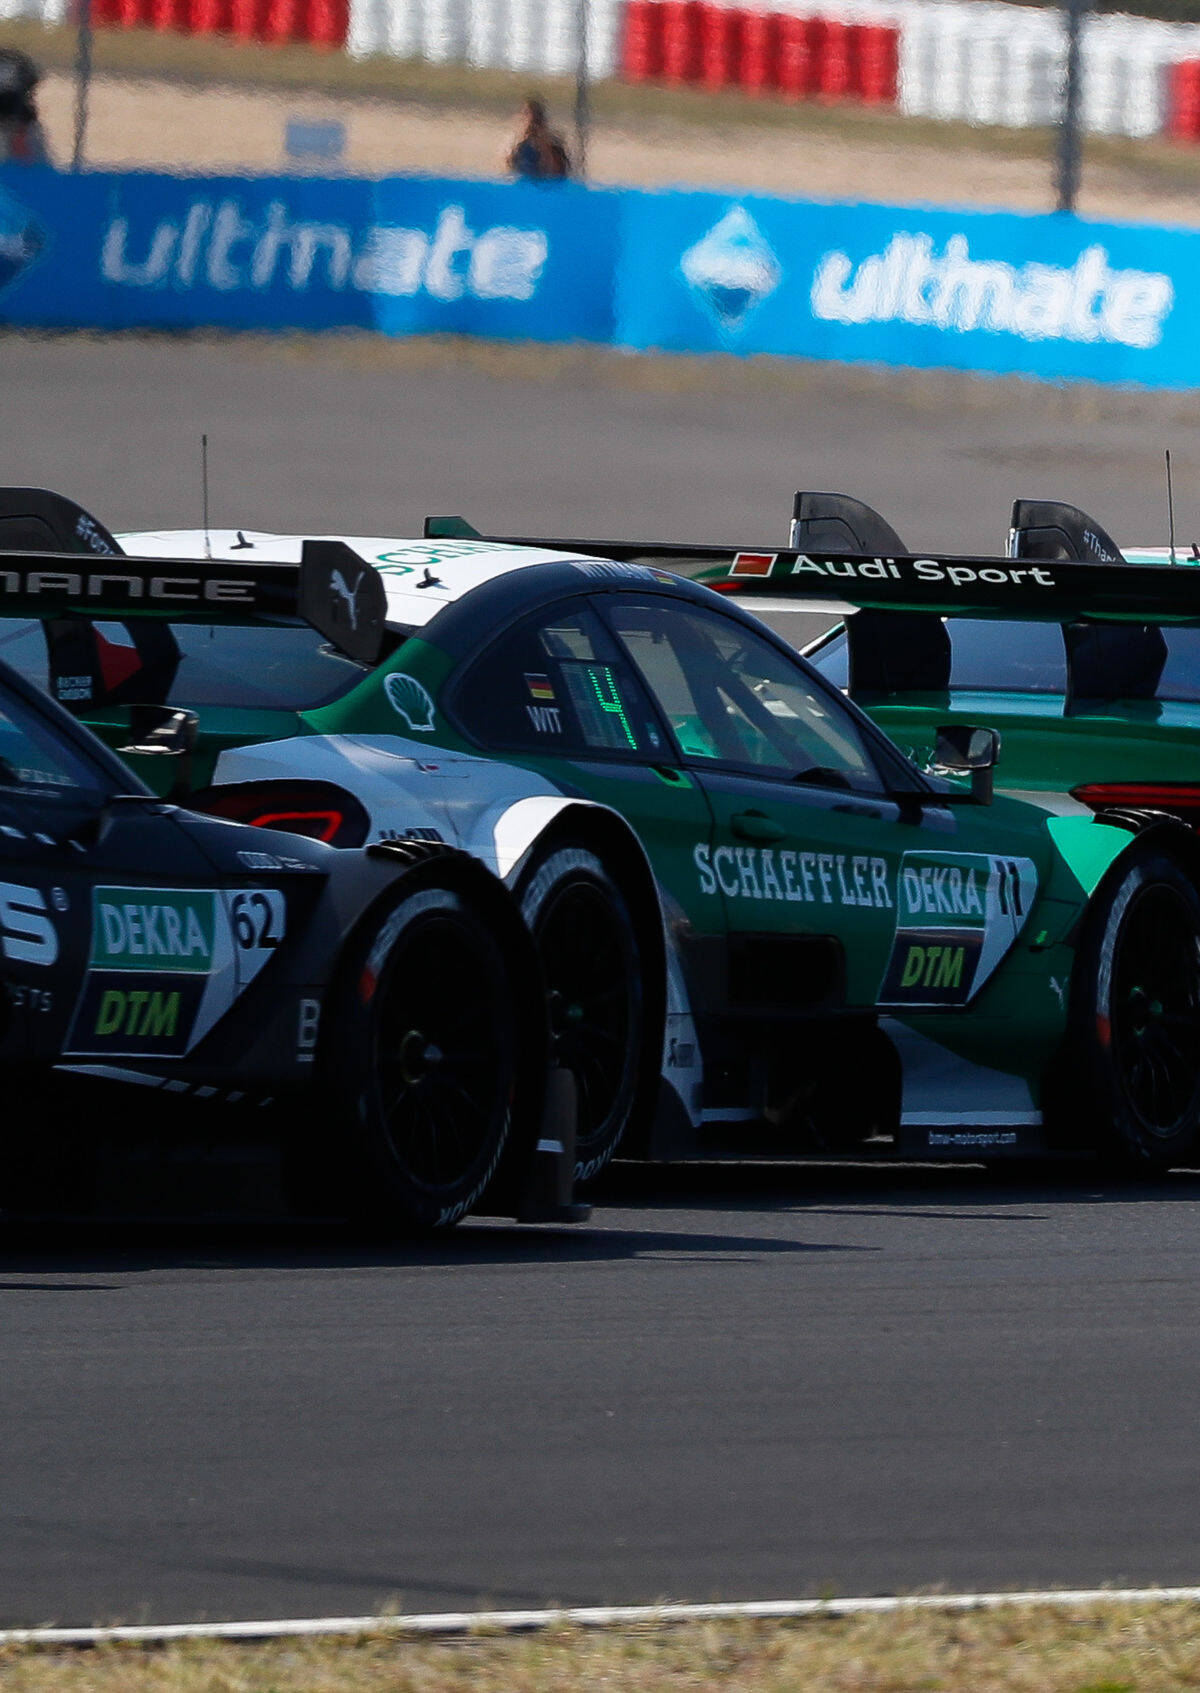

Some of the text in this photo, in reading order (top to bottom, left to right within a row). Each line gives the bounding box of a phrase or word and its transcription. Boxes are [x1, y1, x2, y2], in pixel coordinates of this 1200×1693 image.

[101, 200, 548, 302] ultimate
[811, 231, 1173, 348] ultimate
[791, 554, 1055, 586] Audi Sport
[525, 704, 562, 734] WIT
[587, 666, 638, 751] 4
[692, 843, 894, 908] SCHAEFFLER
[902, 867, 984, 915] DEKRA
[994, 860, 1024, 916] 11
[101, 903, 210, 957] DEKRA
[231, 892, 282, 950] 62
[901, 945, 965, 988] DTM
[94, 989, 182, 1037] DTM
